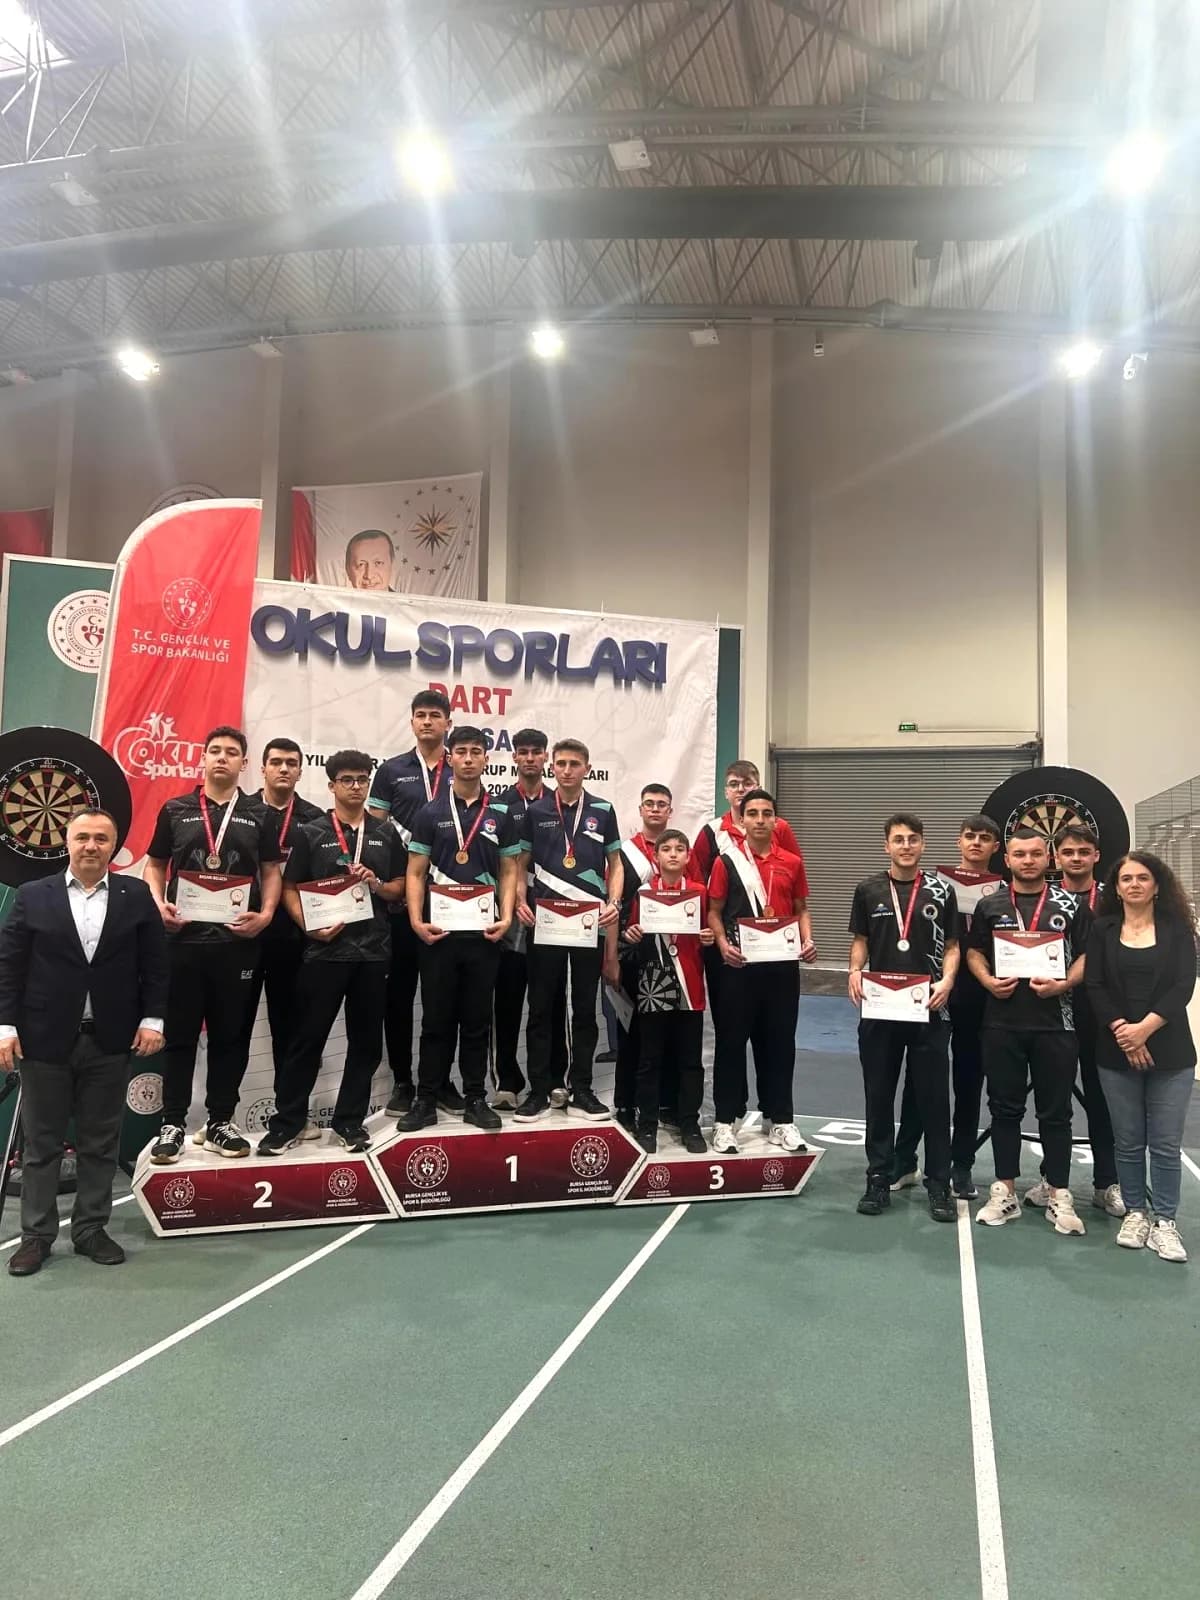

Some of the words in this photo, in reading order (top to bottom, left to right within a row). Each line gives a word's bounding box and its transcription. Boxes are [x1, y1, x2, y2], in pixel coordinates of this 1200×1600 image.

[131, 643, 163, 656] SPOR
[132, 629, 156, 641] T.C.
[213, 639, 231, 649] VE
[250, 604, 412, 661] OKUL
[416, 621, 668, 684] SPORLARI
[481, 765, 506, 776] RUP
[505, 1155, 518, 1182] 1
[709, 1165, 725, 1190] 3
[252, 1181, 273, 1208] 2
